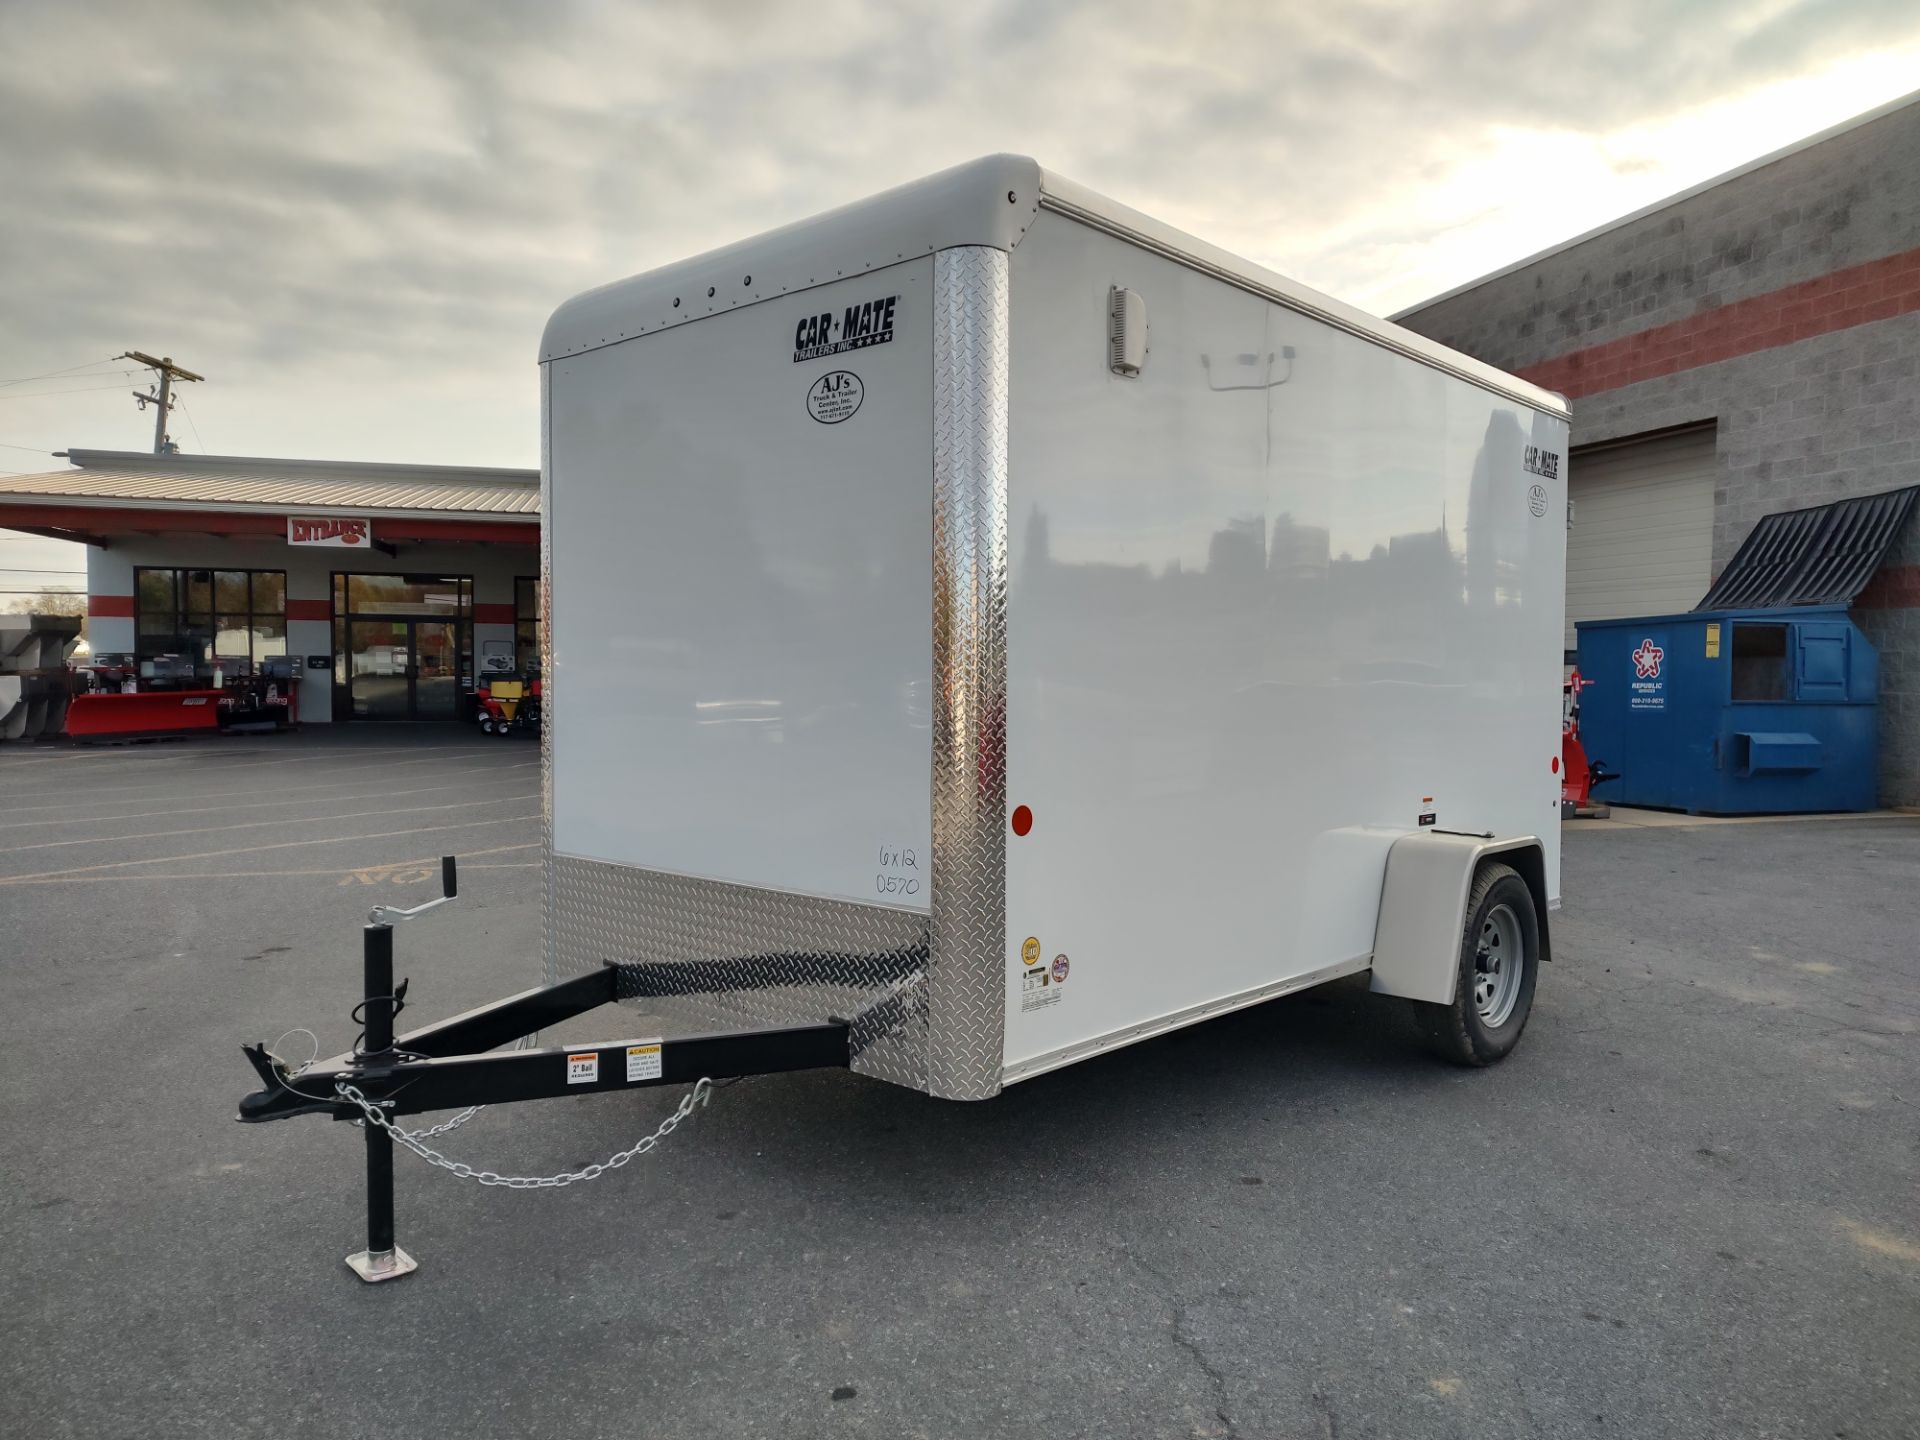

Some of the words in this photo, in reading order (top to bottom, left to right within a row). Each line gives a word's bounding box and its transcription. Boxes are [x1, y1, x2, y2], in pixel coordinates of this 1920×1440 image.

[796, 312, 832, 350] CAR
[842, 296, 896, 340] MATE
[795, 345, 835, 362] TRAILERS
[821, 374, 850, 394] AJ's
[838, 389, 858, 397] Trailer
[1525, 445, 1538, 466] CAR
[1541, 450, 1559, 473] MATE
[292, 519, 367, 542] ENTRANCE
[877, 874, 920, 895] 0570
[581, 1063, 592, 1072] Ball
